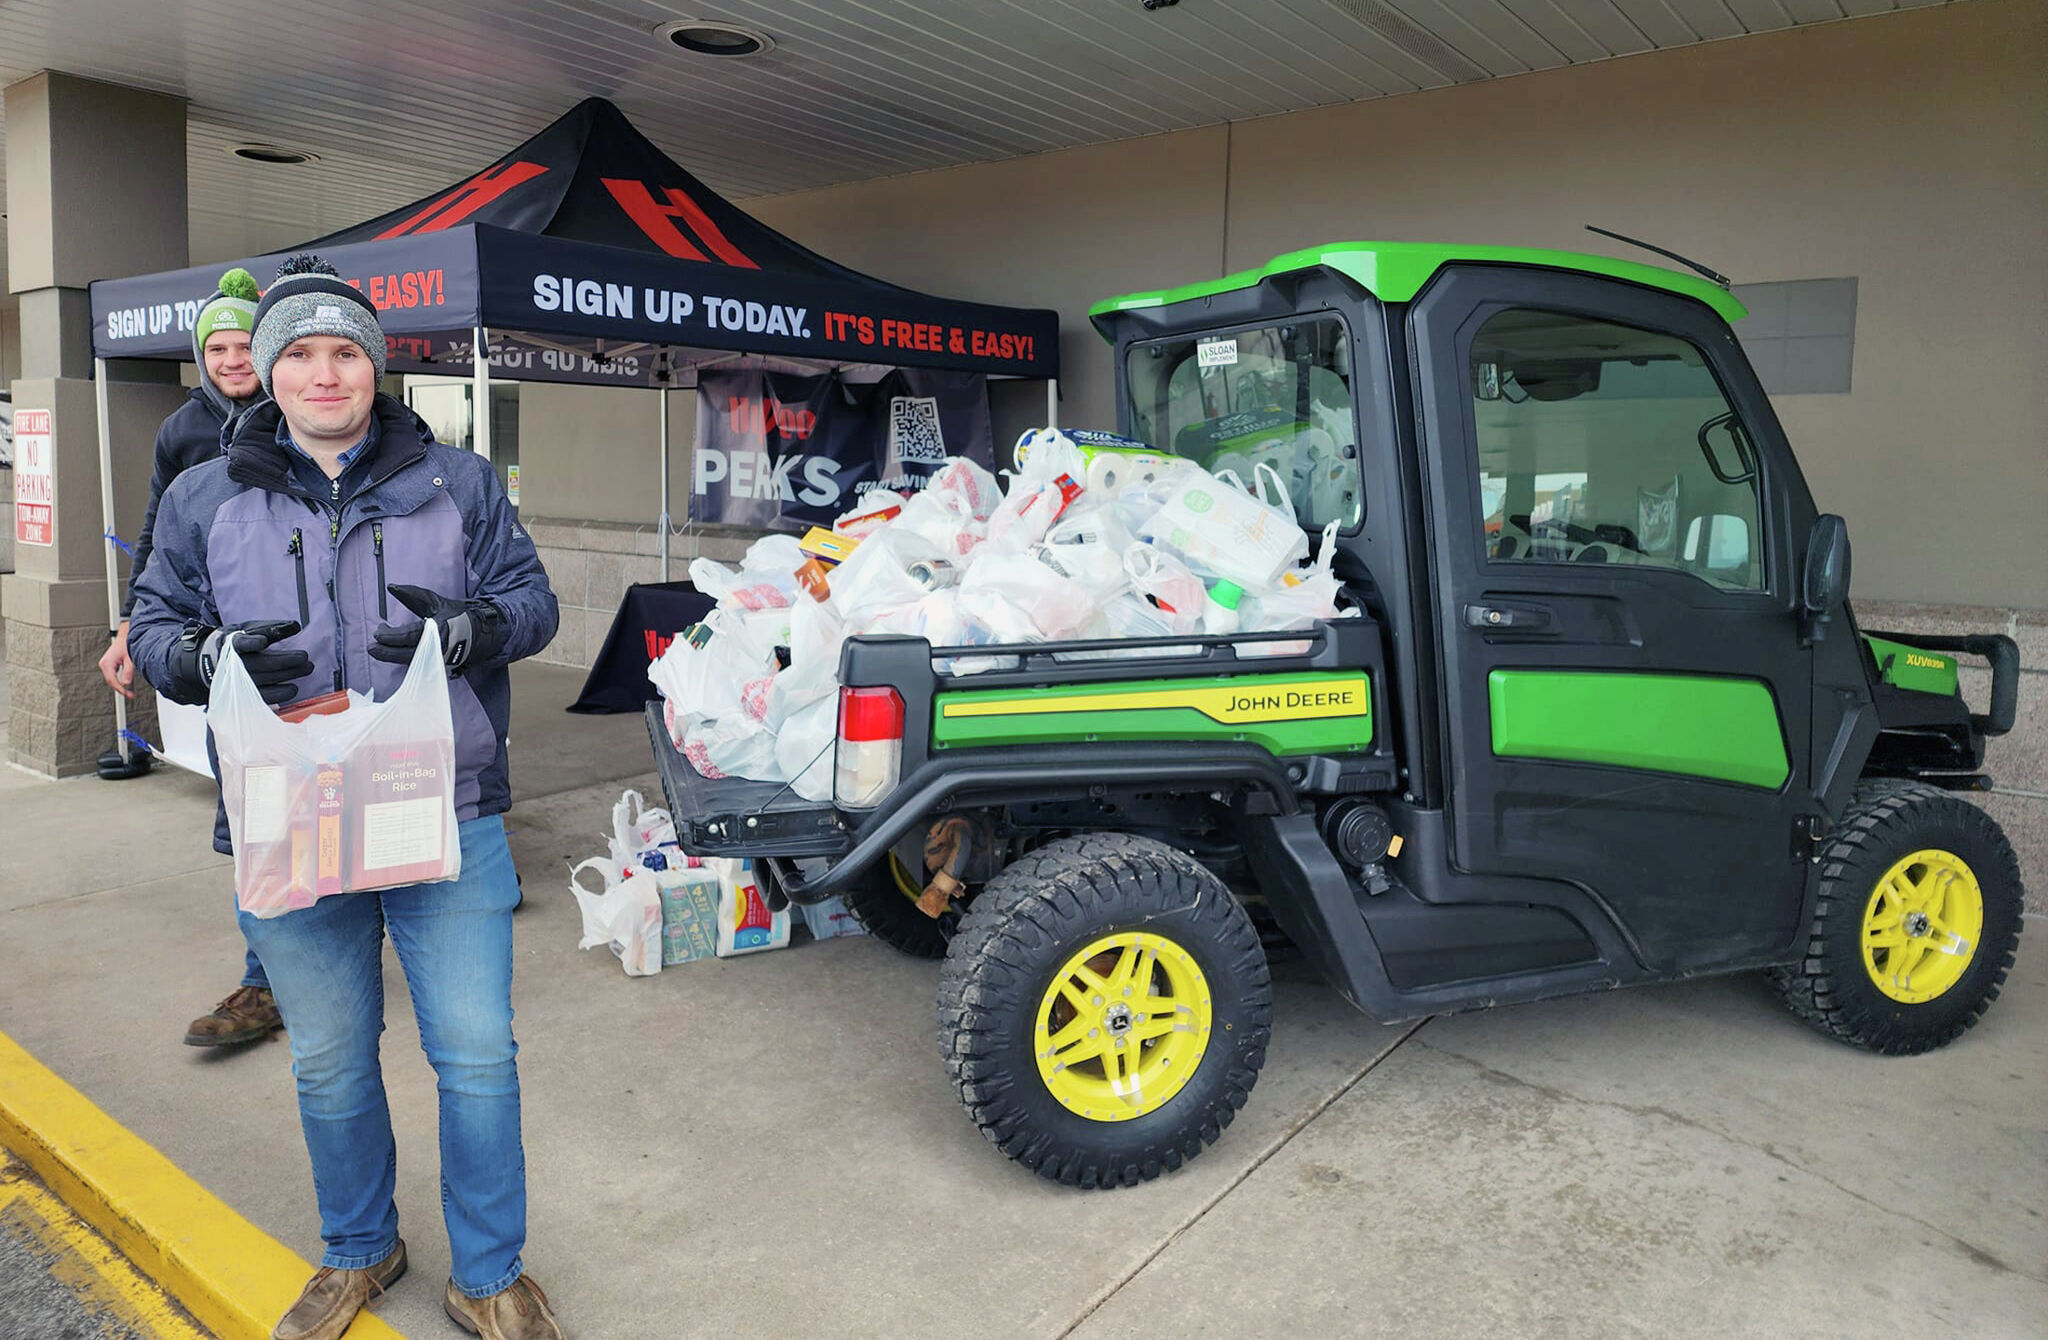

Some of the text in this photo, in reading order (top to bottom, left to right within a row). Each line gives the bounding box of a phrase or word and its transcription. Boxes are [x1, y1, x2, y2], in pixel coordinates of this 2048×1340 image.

[369, 269, 445, 311] EASY!
[107, 307, 145, 340] SIGN
[149, 304, 172, 335] UP
[533, 274, 1035, 362] SIGN UP TODAY. IT'S FREE & EASY!
[1209, 344, 1235, 357] SLOAN
[16, 415, 49, 432] FIRE LANE
[27, 440, 38, 467] NO
[16, 474, 51, 501] PARKING
[854, 474, 929, 494] START SAVIN
[18, 505, 49, 524] TOW-AWAY
[25, 523, 43, 542] ZONE
[1226, 692, 1353, 712] JOHN DEERE
[372, 768, 436, 782] Boil-in-Bag
[392, 781, 417, 792] Rice
